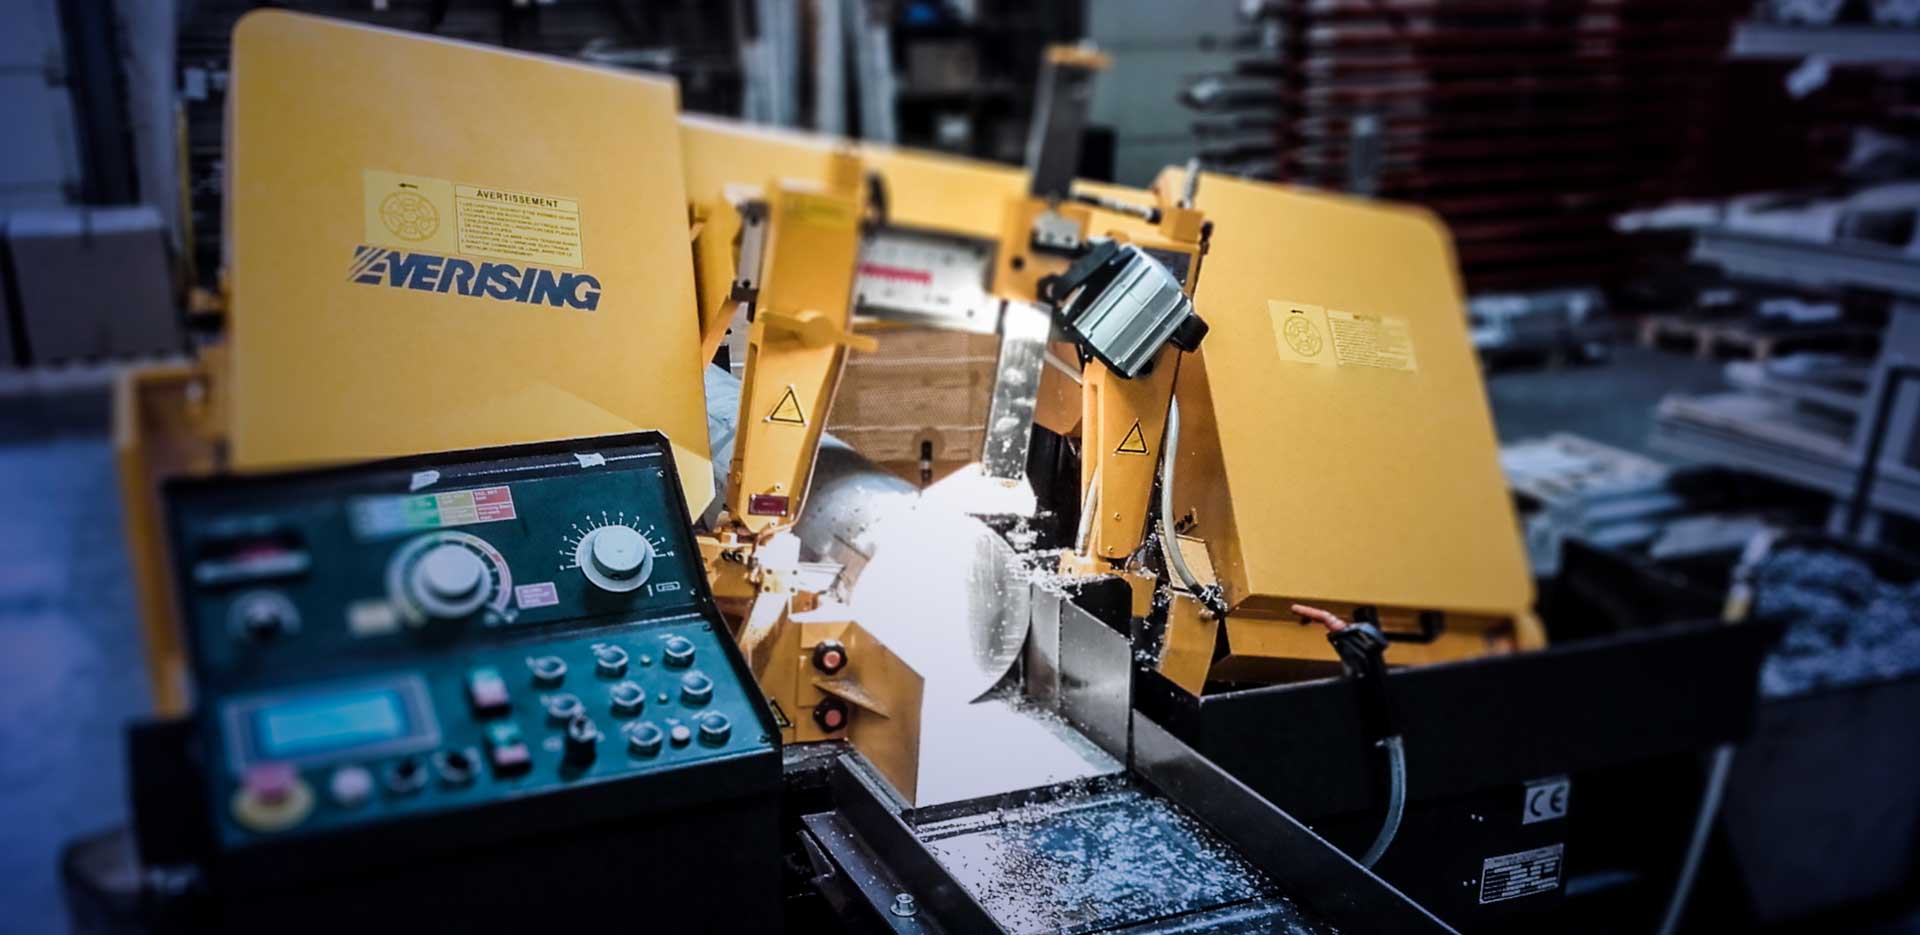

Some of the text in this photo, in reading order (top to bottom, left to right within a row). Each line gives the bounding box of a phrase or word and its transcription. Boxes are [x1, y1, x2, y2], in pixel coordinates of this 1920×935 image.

[476, 189, 559, 208] AVERTISSEMENT
[347, 246, 601, 311] EVERISING
[1529, 785, 1565, 817] CE
